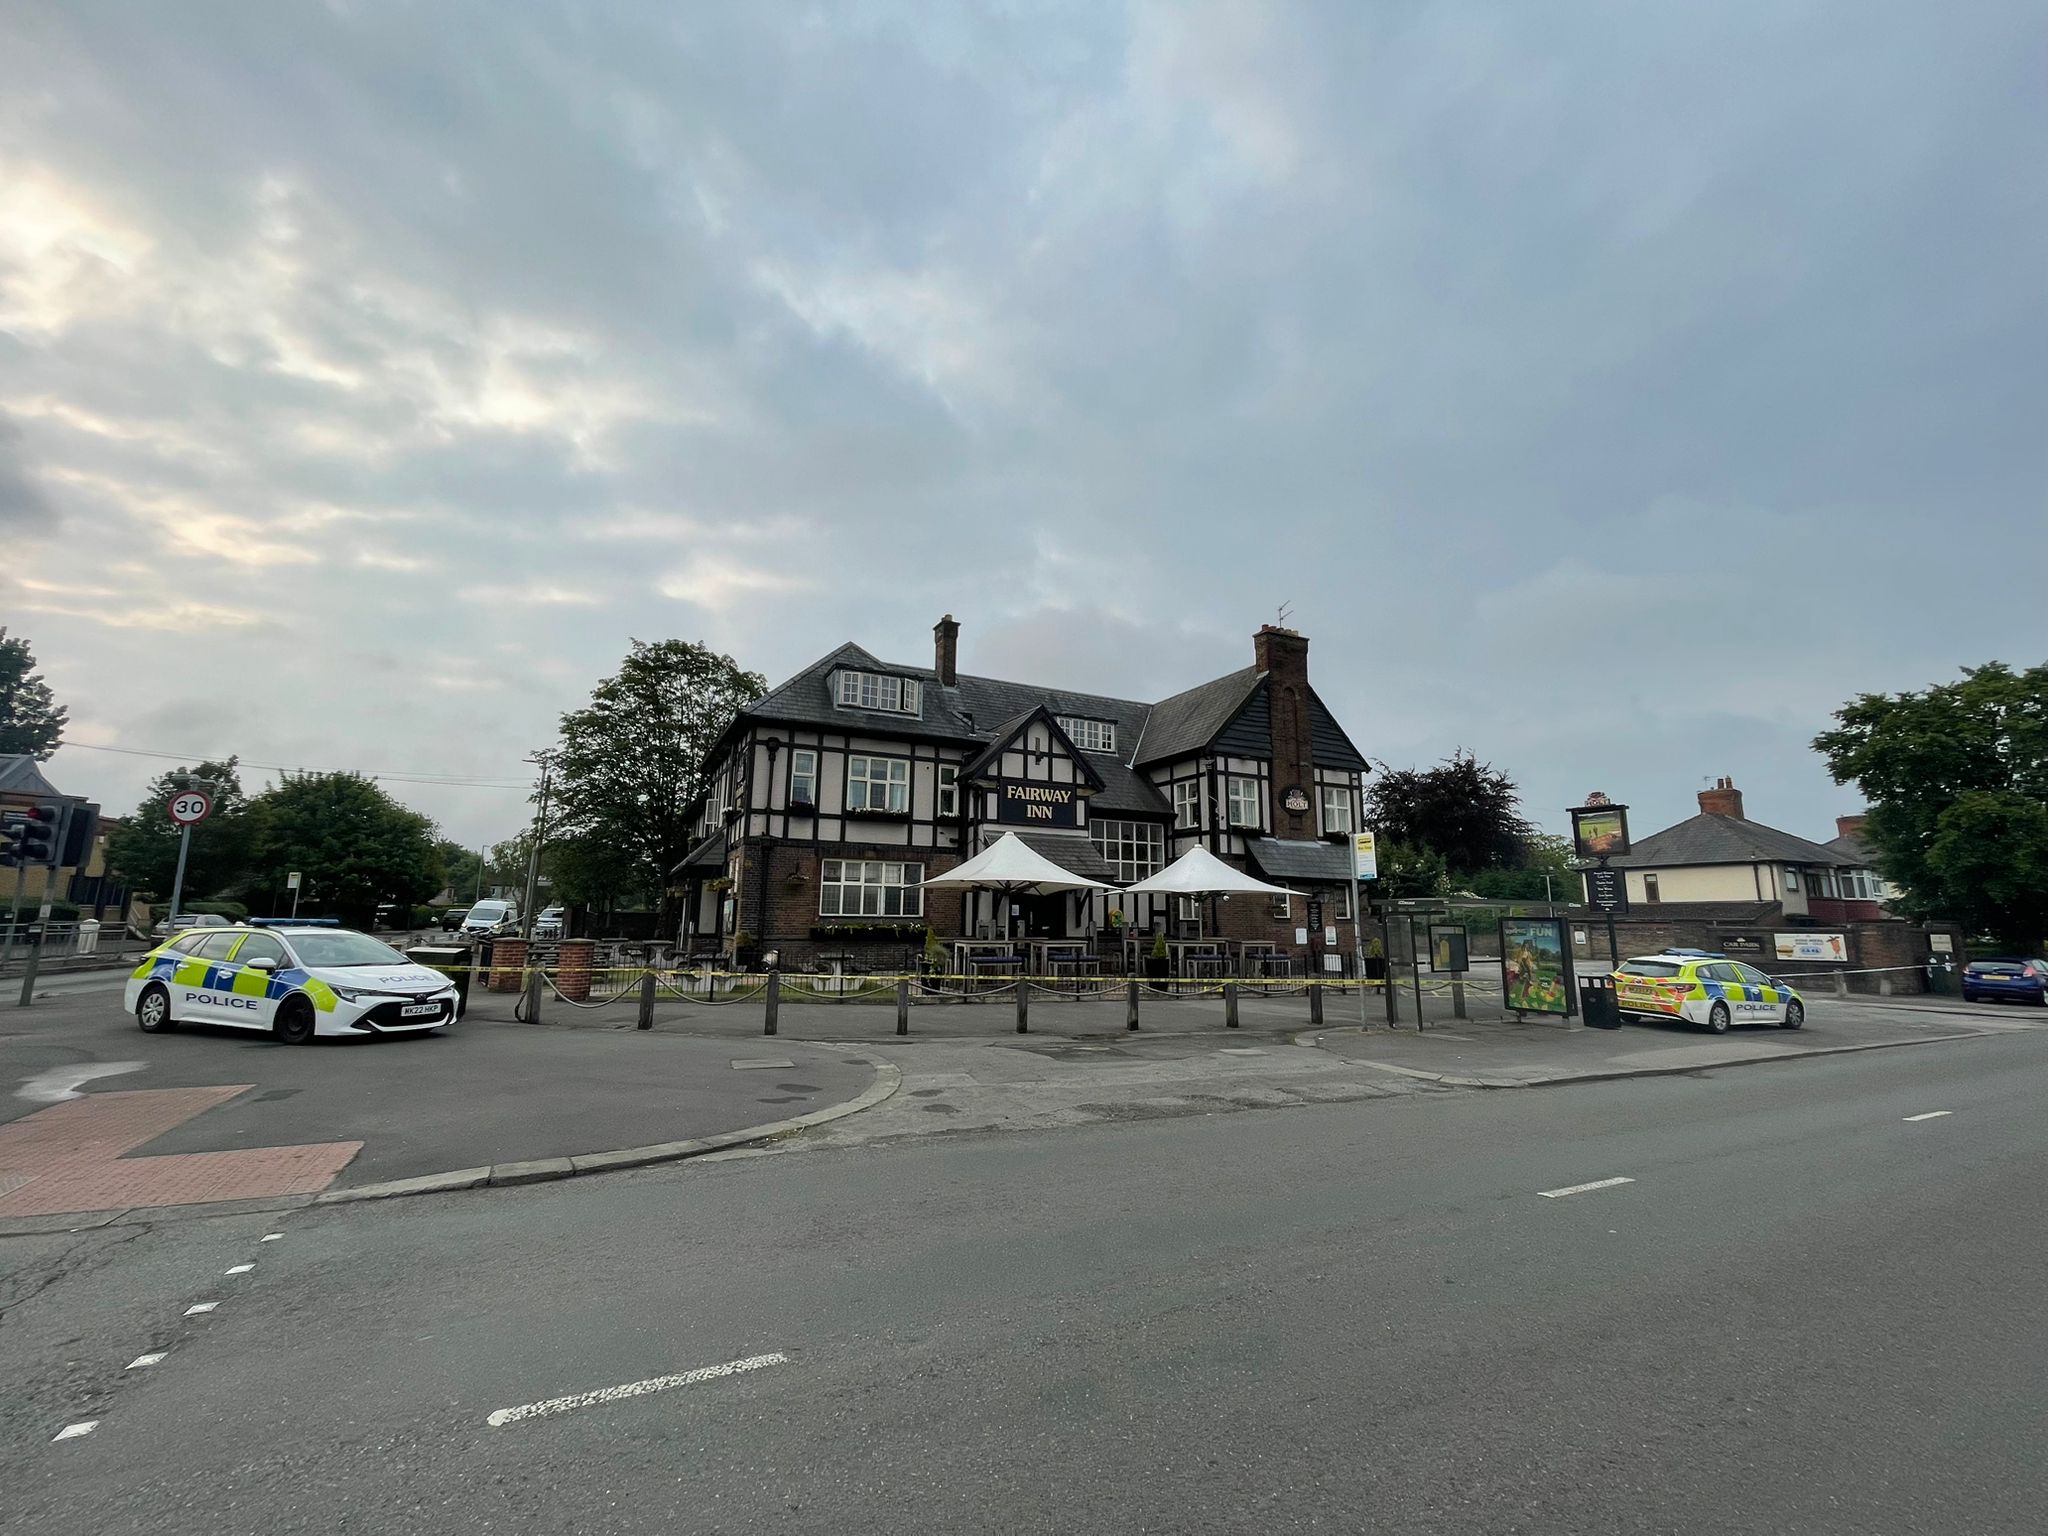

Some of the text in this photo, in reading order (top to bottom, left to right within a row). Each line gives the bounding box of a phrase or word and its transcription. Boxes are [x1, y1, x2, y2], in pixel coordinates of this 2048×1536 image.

[1007, 785, 1071, 803] FAIRWAY
[176, 801, 204, 814] 30
[1026, 804, 1053, 819] INN
[1530, 927, 1553, 937] FUN
[186, 992, 258, 1010] POLICE
[1621, 1001, 1656, 1009] POLICE
